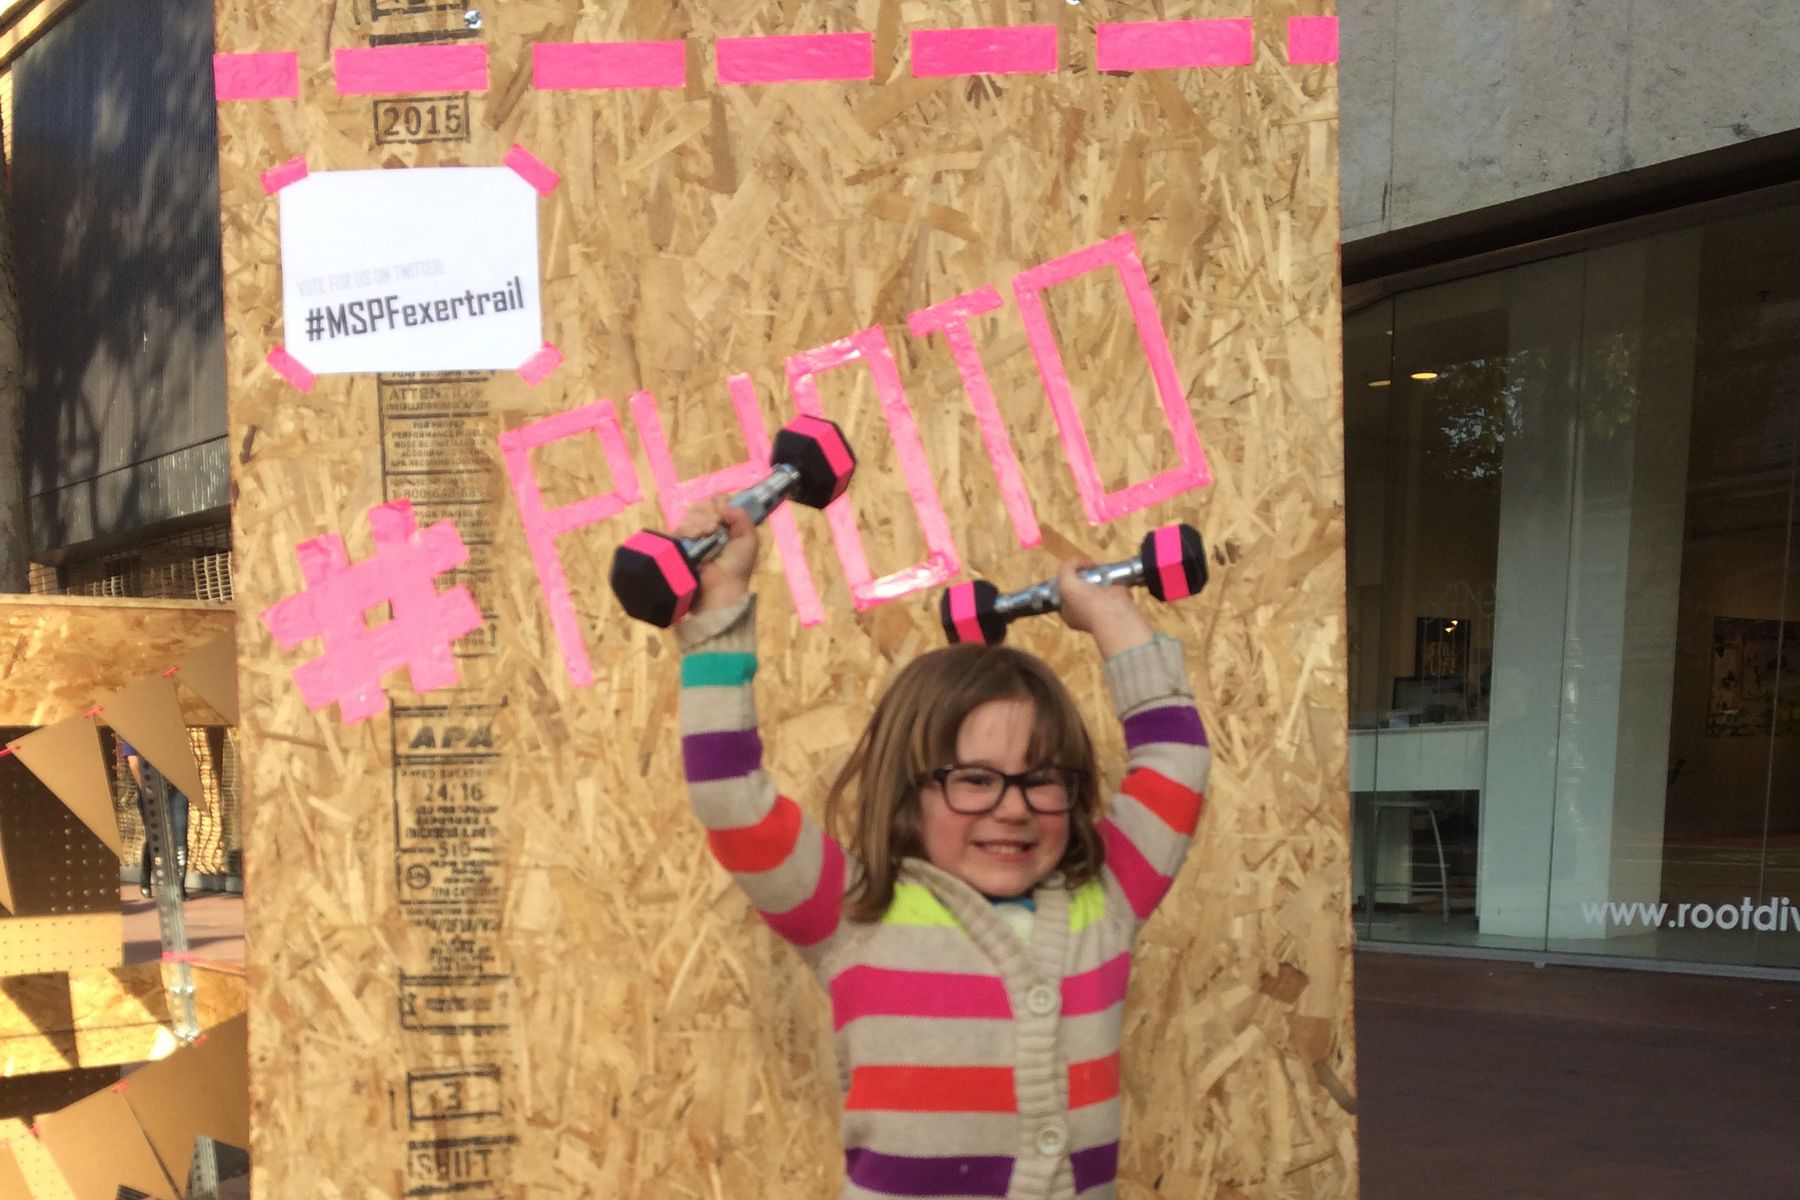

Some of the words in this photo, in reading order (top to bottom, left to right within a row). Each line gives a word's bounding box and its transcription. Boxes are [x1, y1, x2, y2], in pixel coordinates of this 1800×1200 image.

[383, 104, 462, 136] 2015
[297, 277, 326, 296] VOTE
[328, 273, 352, 291] FOR
[354, 269, 371, 288] US
[374, 266, 391, 285] ON
[305, 275, 524, 341] #MSPFexertrail
[408, 726, 493, 749] APA
